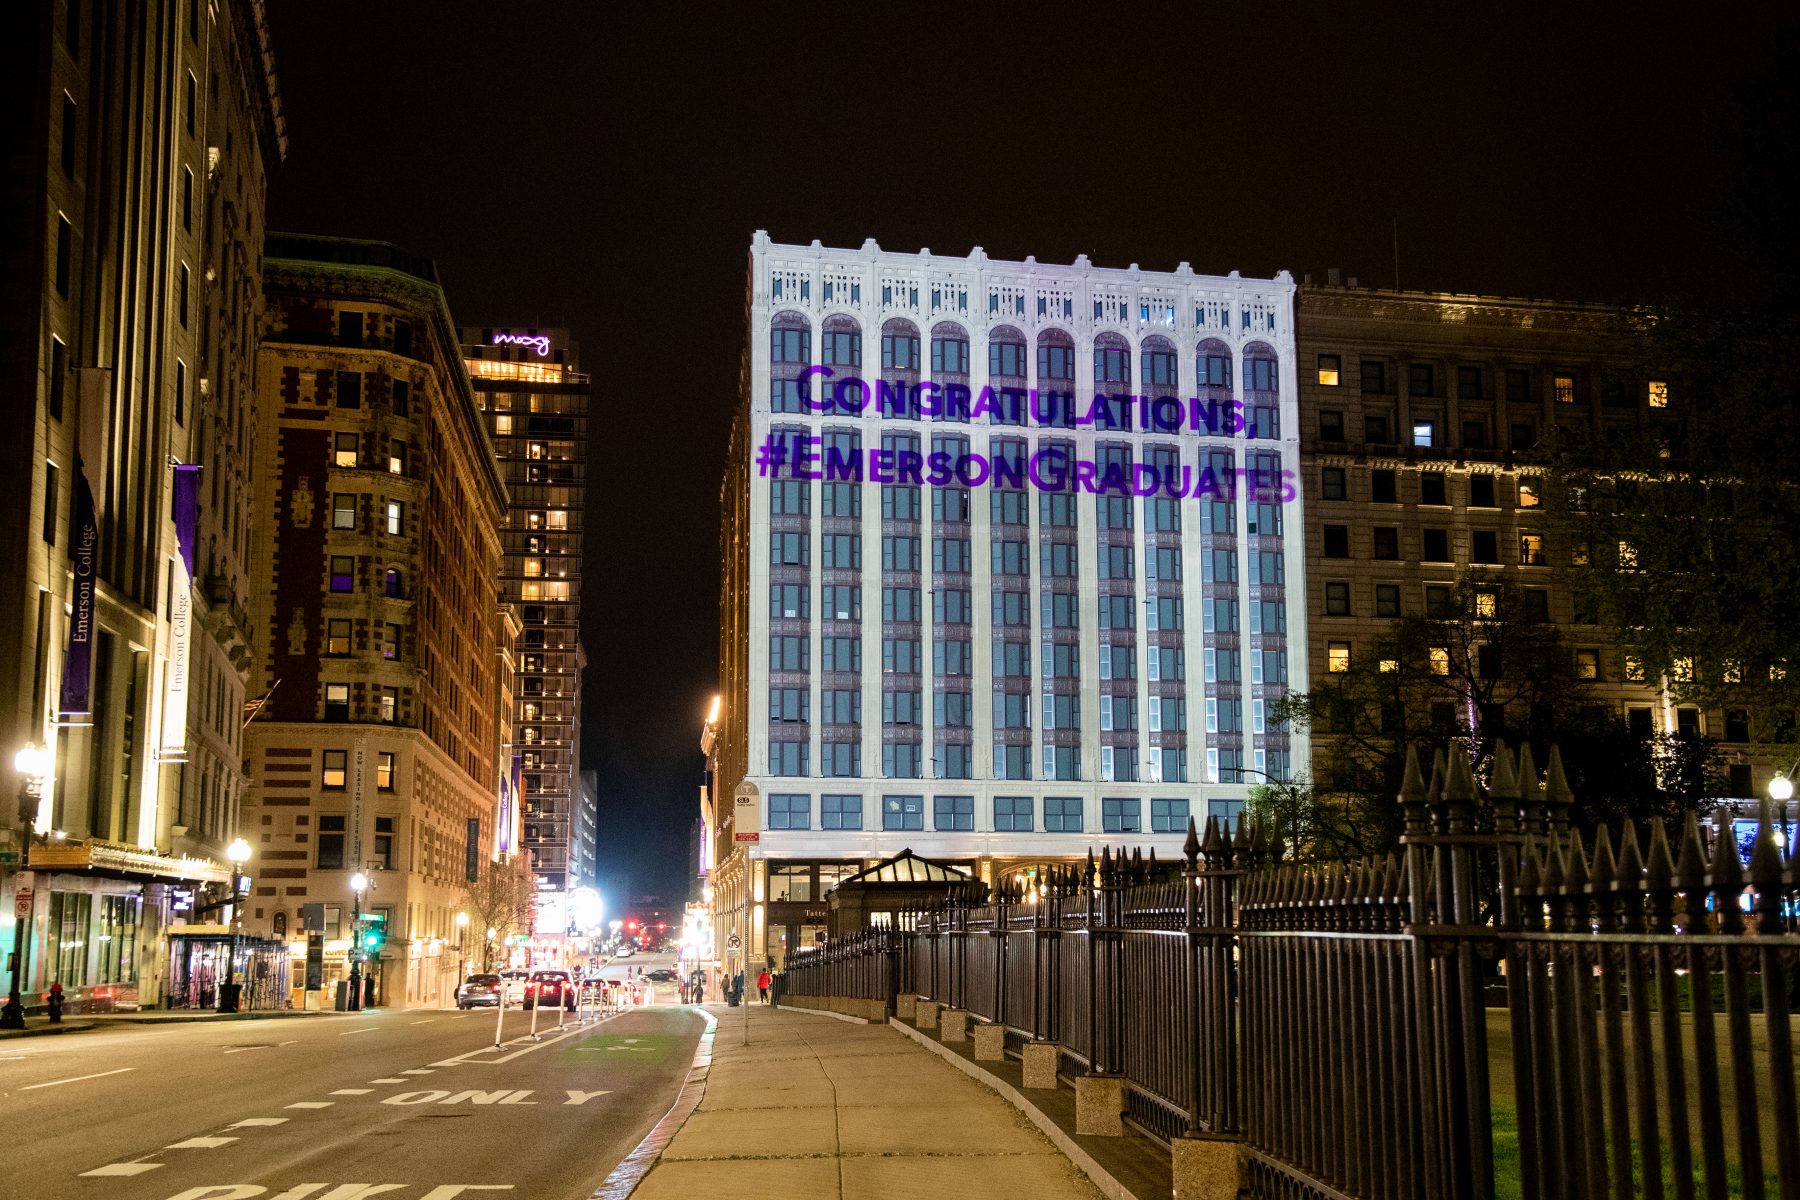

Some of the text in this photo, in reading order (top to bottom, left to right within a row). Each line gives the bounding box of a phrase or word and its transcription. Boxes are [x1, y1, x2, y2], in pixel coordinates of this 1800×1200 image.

[494, 334, 550, 356] moxy
[72, 523, 96, 643] Emerson College
[171, 593, 188, 693] Emerson College
[804, 909, 827, 917] Tatte
[381, 1089, 615, 1105] ONLY
